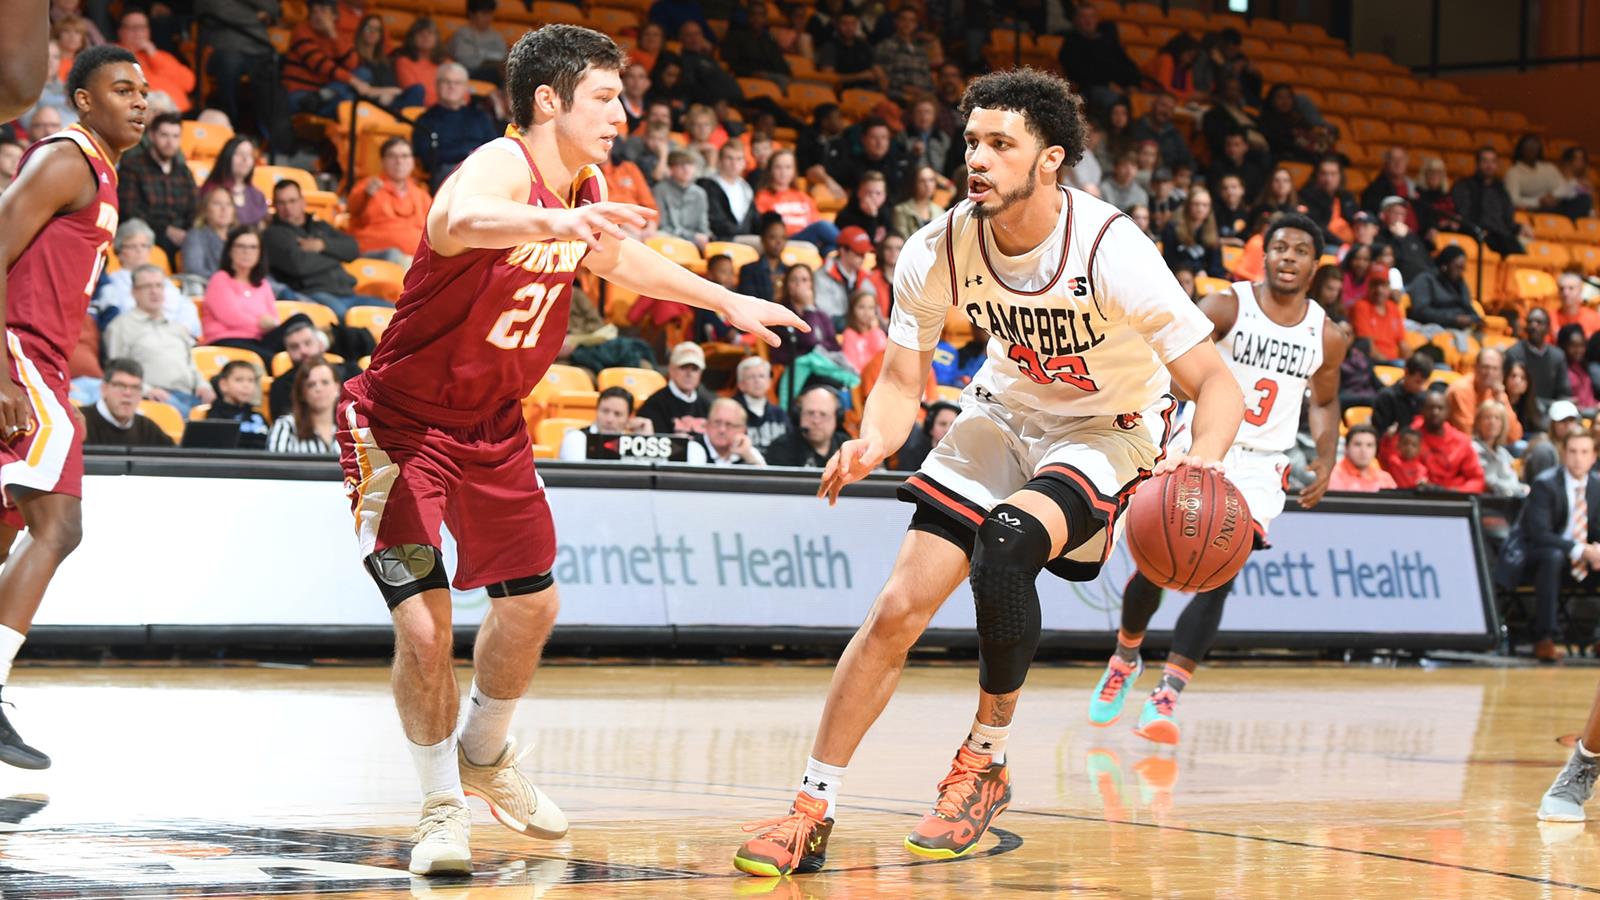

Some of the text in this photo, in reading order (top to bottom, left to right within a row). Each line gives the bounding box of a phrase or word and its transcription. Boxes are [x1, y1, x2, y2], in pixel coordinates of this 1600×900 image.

[485, 282, 566, 350] 21
[966, 301, 1106, 356] CAMPBELL
[1008, 343, 1100, 392] 32
[1232, 330, 1316, 380] CAMPBELL
[1243, 377, 1279, 427] 3
[619, 436, 673, 458] POSS
[556, 532, 853, 589] arnett Health
[1238, 548, 1442, 599] nett Health
